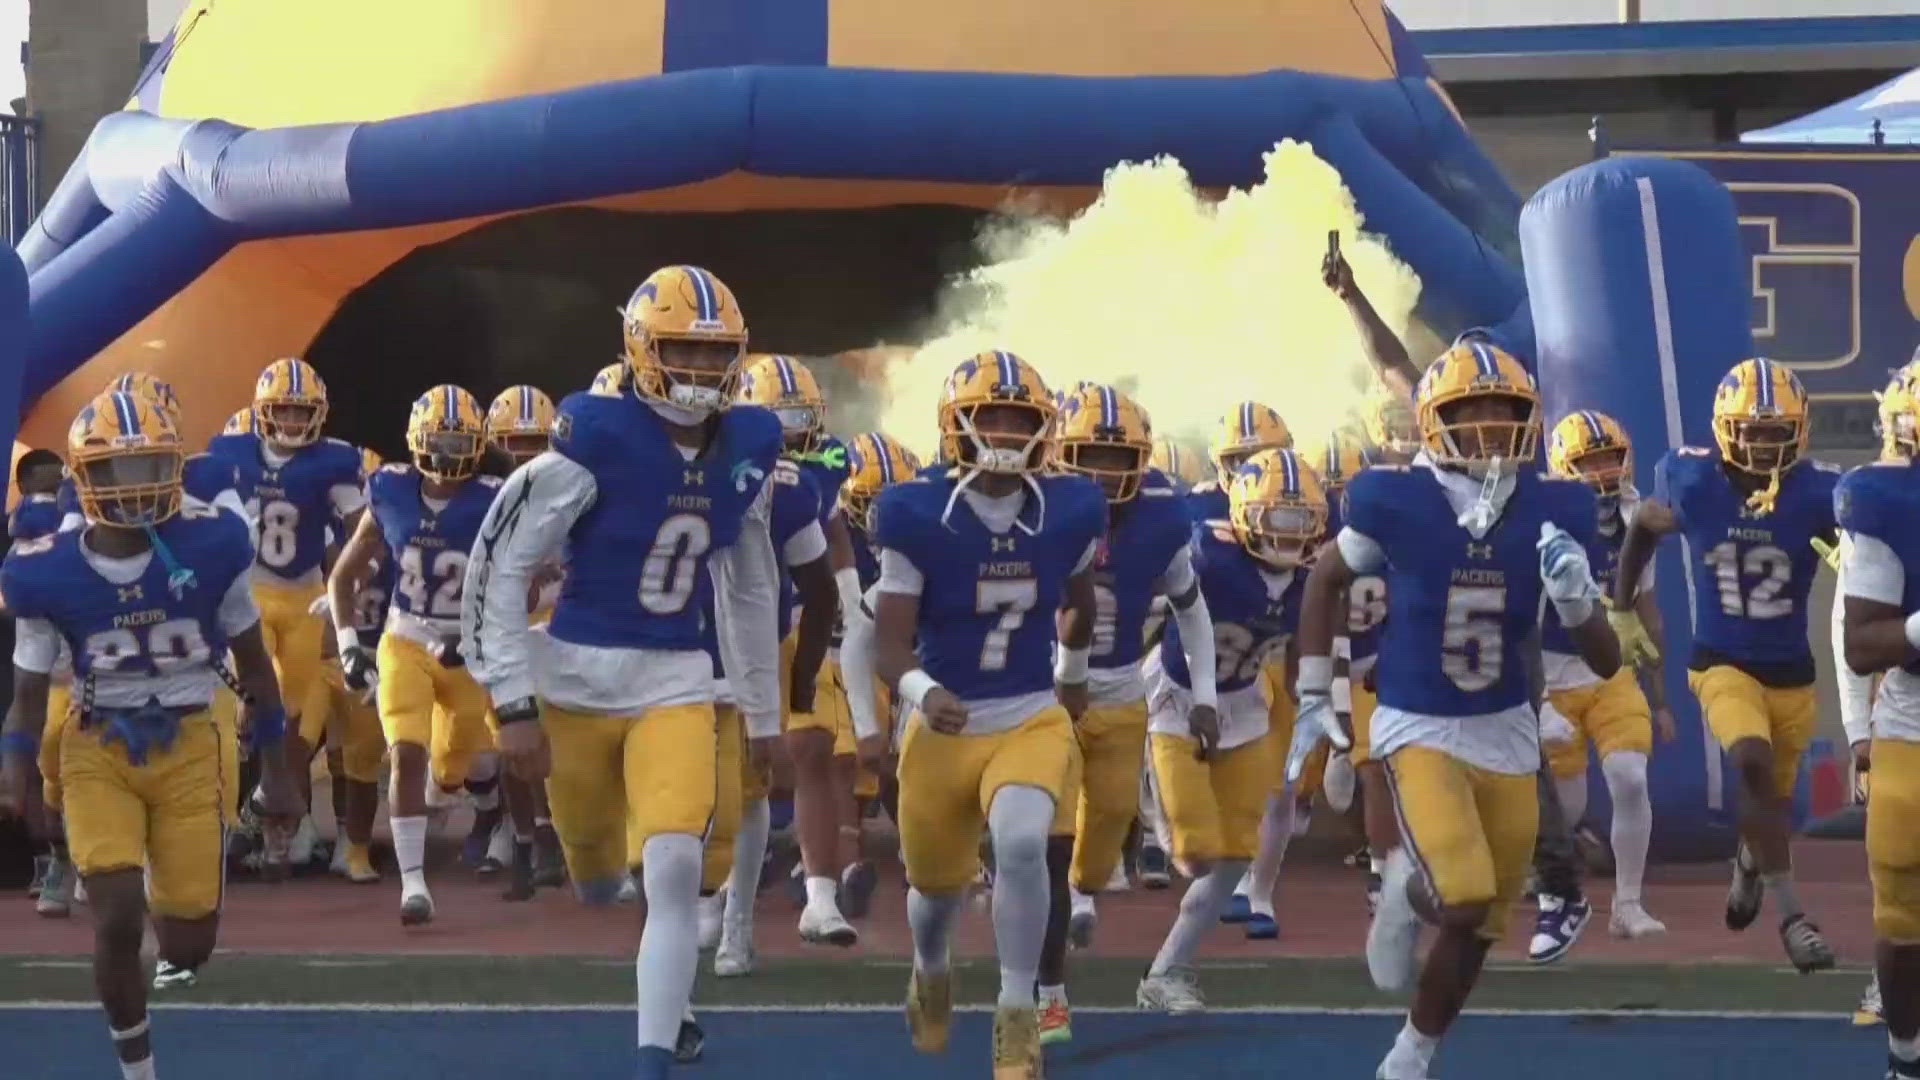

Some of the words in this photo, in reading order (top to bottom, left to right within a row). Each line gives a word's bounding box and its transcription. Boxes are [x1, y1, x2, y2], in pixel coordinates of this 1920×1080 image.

[667, 495, 712, 510] PACERS
[1728, 527, 1773, 542] PACERS
[400, 545, 469, 615] 42
[638, 514, 710, 614] 0
[979, 561, 1032, 576] PACERS
[1452, 568, 1504, 584] PACERS
[1703, 542, 1793, 619] 12
[113, 609, 166, 629] PACERS
[976, 578, 1037, 670] 7
[1441, 585, 1507, 692] 5
